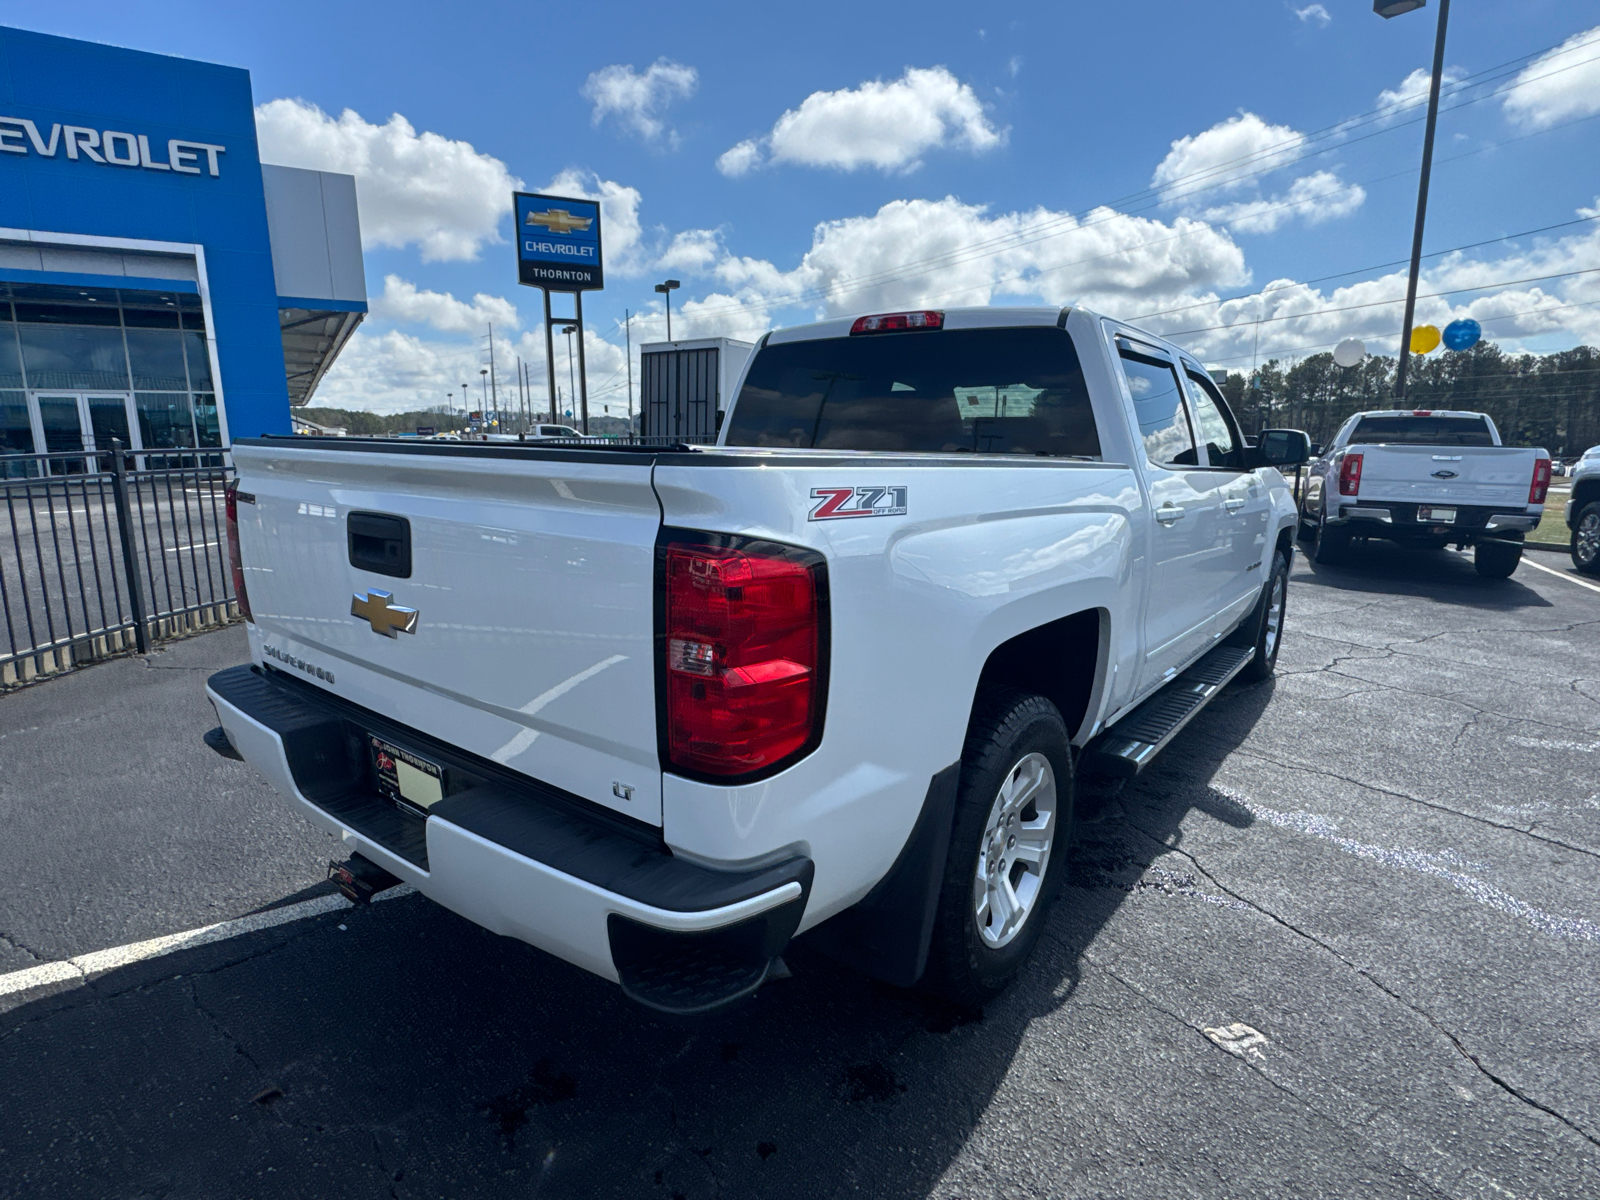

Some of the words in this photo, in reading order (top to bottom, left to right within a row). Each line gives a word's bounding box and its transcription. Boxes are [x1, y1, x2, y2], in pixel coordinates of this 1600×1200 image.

[0, 116, 226, 177] EVROLET
[525, 241, 594, 256] CHEVROLET
[533, 268, 591, 281] THORNTON
[807, 486, 907, 522] Z71
[612, 781, 635, 801] LT
